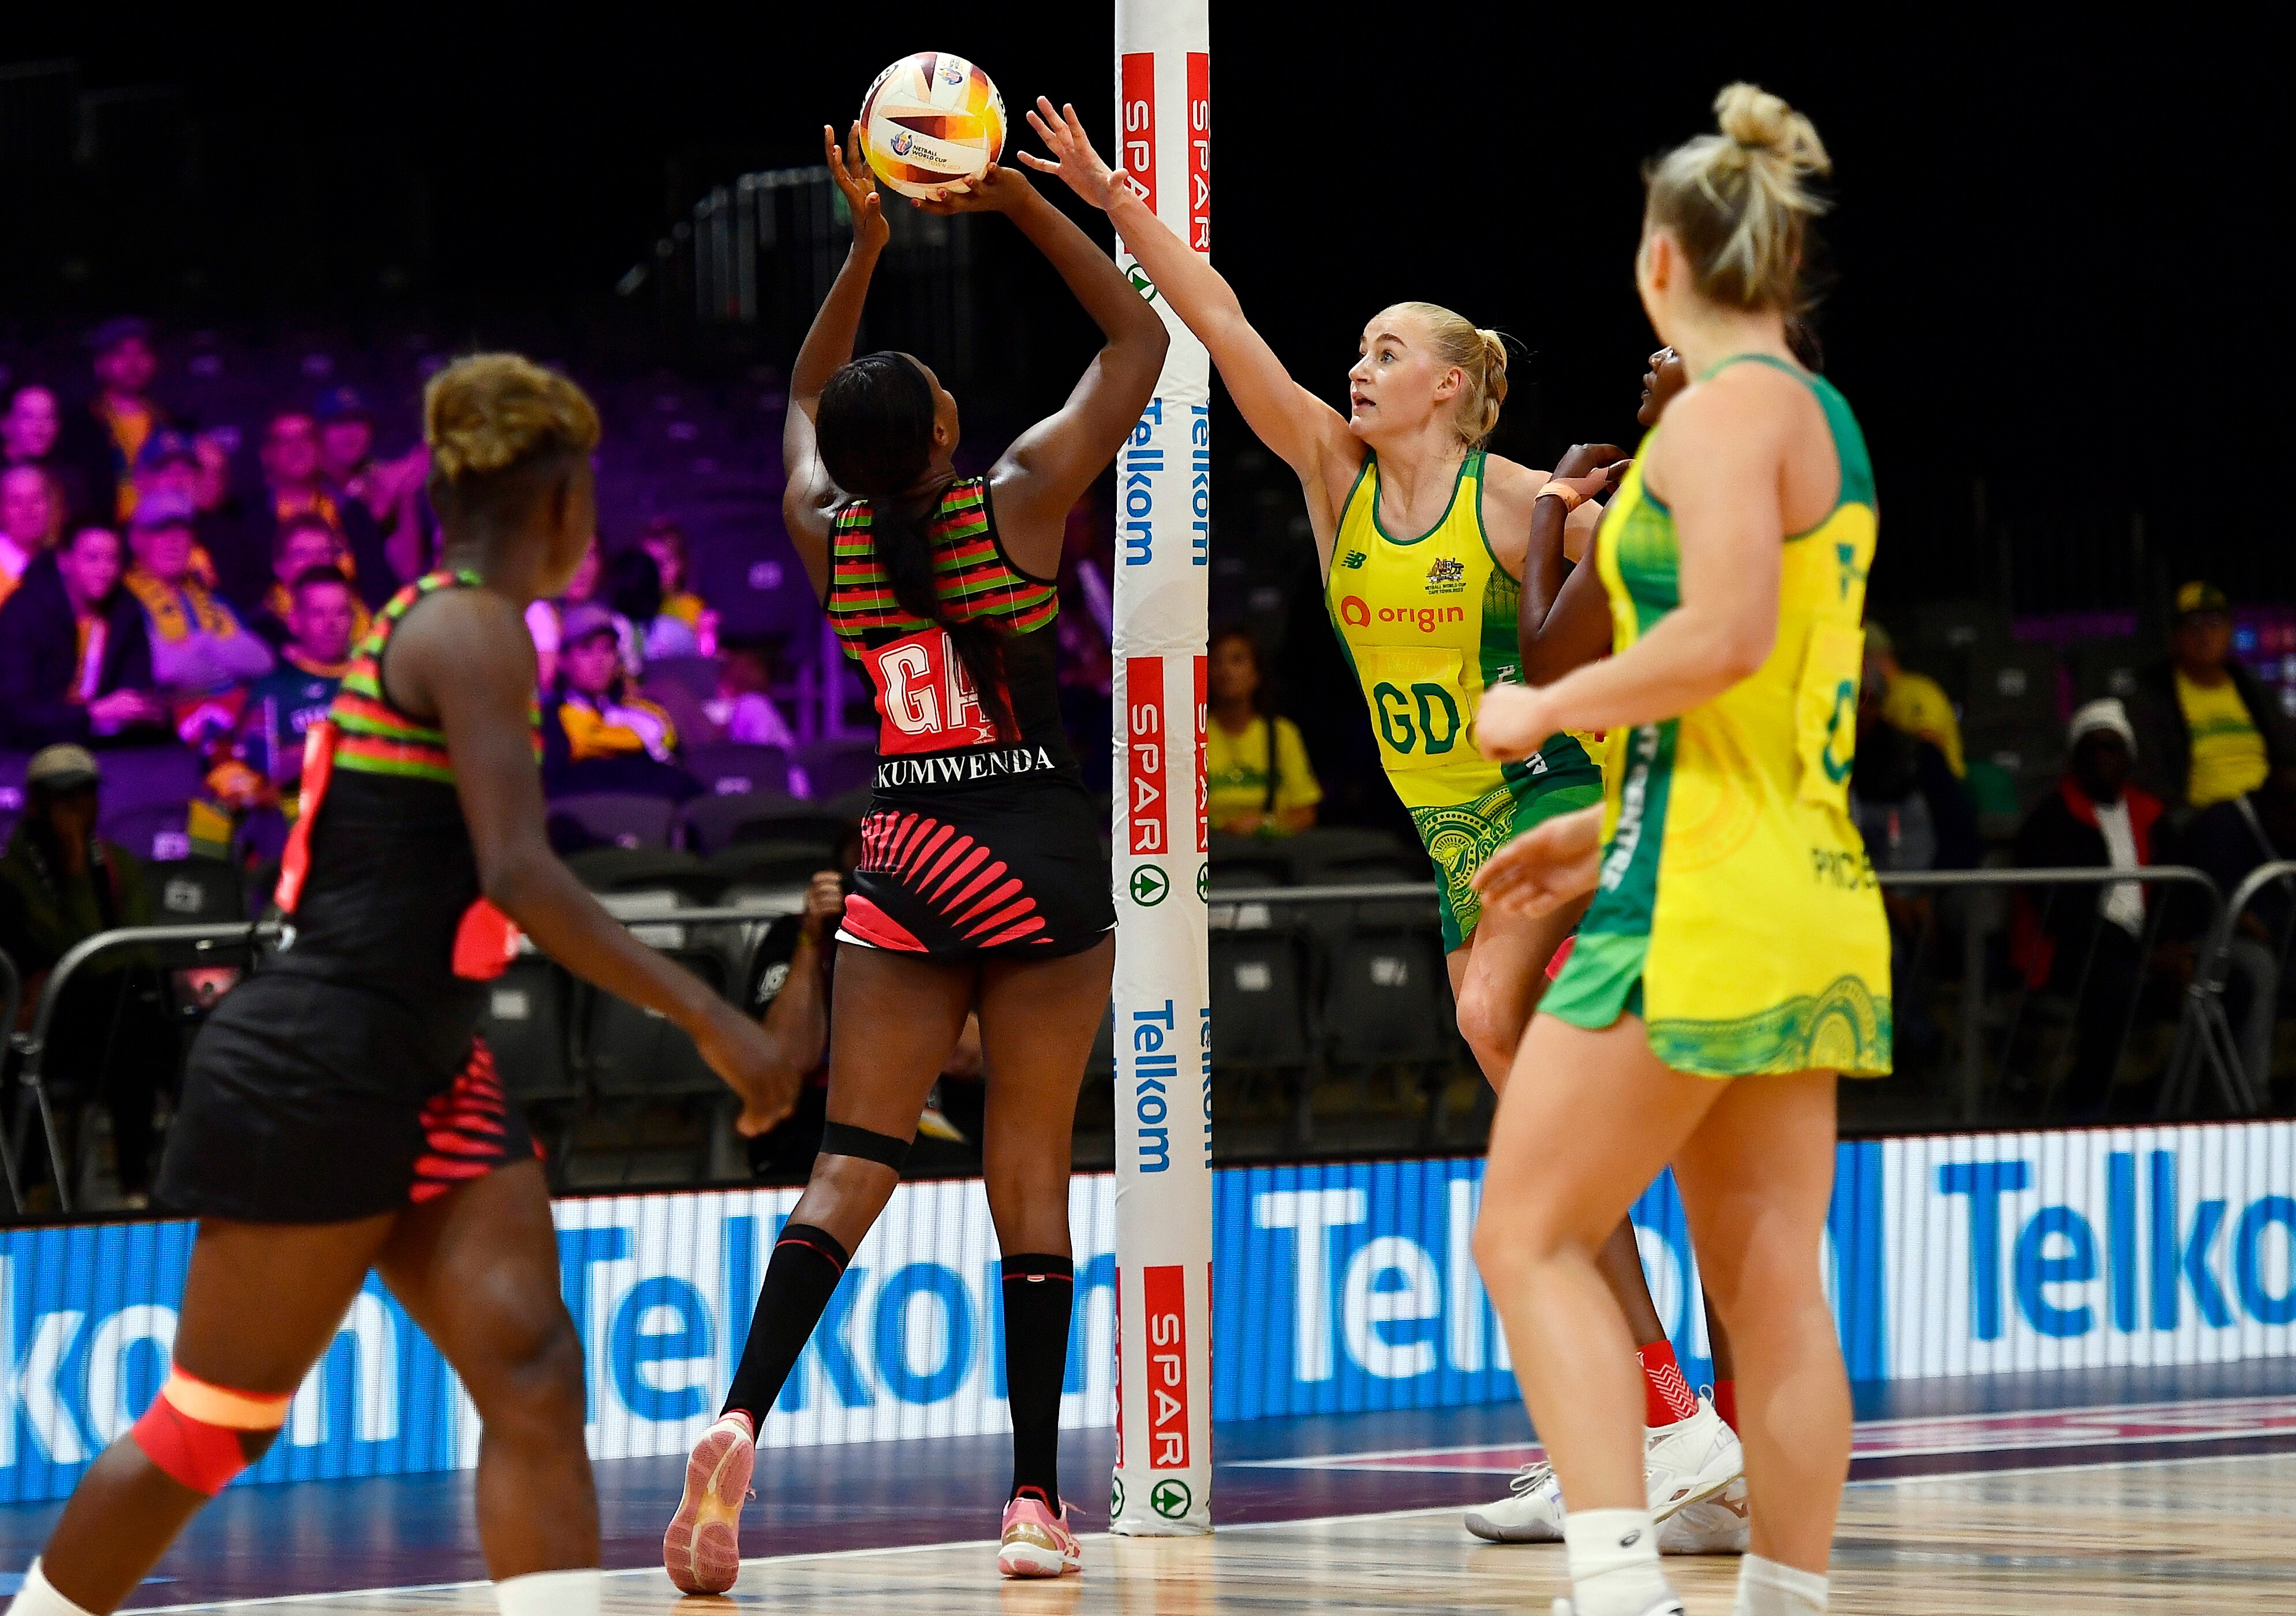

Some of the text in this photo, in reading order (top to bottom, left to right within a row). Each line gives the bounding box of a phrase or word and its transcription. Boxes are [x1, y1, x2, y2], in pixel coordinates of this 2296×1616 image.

[912, 150, 934, 160] WORLD
[913, 145, 937, 156] NETBALL
[1126, 100, 1150, 203] SPA
[1192, 99, 1209, 248] SPAR
[1127, 398, 1164, 566] Telkom
[1378, 606, 1464, 633] origin
[878, 746, 1056, 788] KUMWENDA
[1373, 681, 1460, 755] GD
[1132, 703, 1161, 851] SPAR
[1132, 999, 1177, 1173] Telkom
[1151, 1313, 1184, 1466] SPAR
